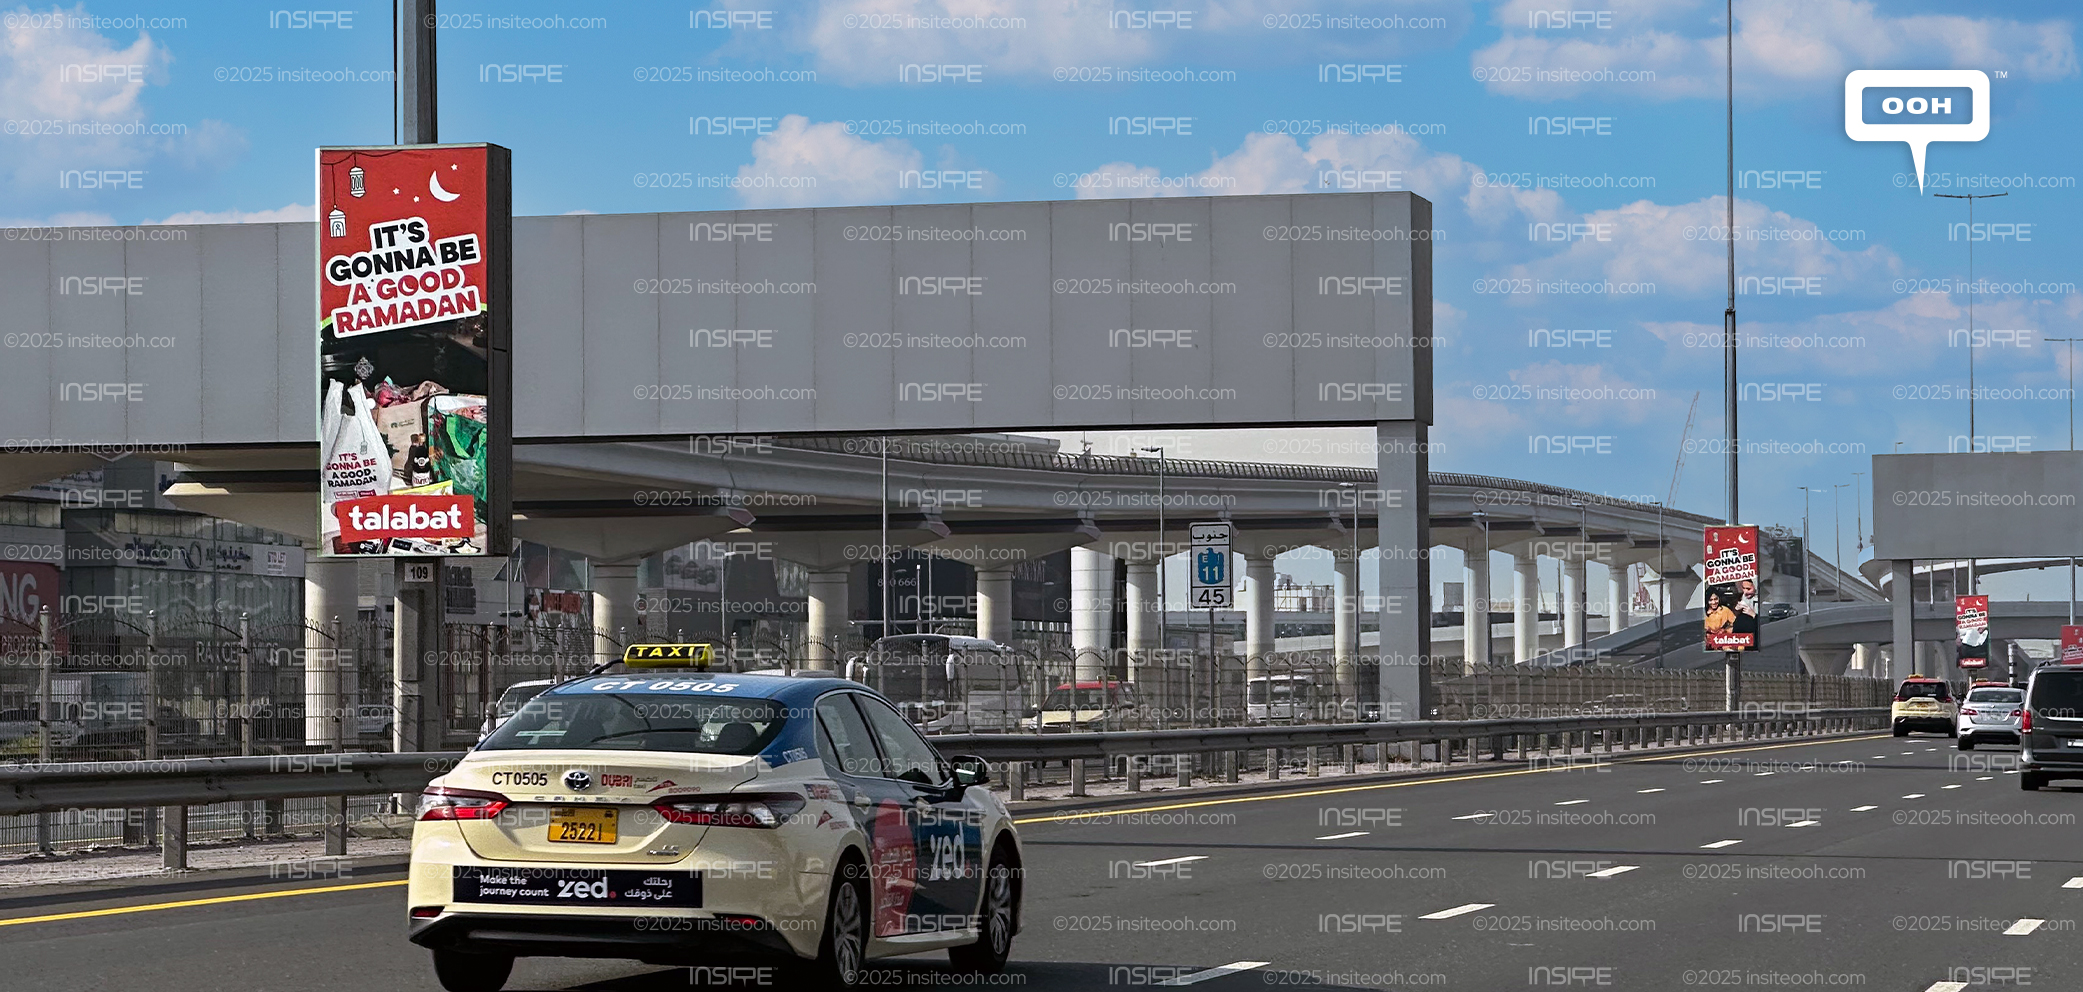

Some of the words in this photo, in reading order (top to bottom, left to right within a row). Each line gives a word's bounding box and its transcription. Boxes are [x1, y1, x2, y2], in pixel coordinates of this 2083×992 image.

[373, 221, 425, 249] IT'S
[329, 245, 435, 282] GONNA
[439, 238, 477, 264] BE
[351, 283, 372, 305] A
[376, 268, 461, 300] GOOD
[335, 290, 478, 334] RAMADAN
[338, 453, 358, 461] IT'S
[325, 461, 362, 471] GONNA
[363, 458, 377, 467] BE
[340, 469, 371, 479] GOOD
[327, 475, 377, 488] RAMADAN
[348, 503, 462, 531] talabat
[1192, 530, 1229, 543] جنوب
[1721, 549, 1738, 557] IT'S
[1707, 557, 1741, 568] GONNA
[1742, 554, 1754, 563] BE
[410, 566, 428, 579] 109
[1202, 566, 1219, 581] 11
[1714, 567, 1721, 575] A
[1722, 563, 1749, 573] GOOD
[1708, 570, 1754, 584] RAMADAN
[1198, 588, 1225, 605] 45
[1713, 636, 1750, 645] talabat
[636, 647, 695, 658] TAXI
[592, 681, 645, 691] CT
[648, 681, 740, 693] 0505
[492, 771, 548, 786] CT0505
[480, 875, 508, 886] Make
[509, 875, 528, 886] the
[479, 885, 517, 898] journey
[518, 887, 550, 898] count
